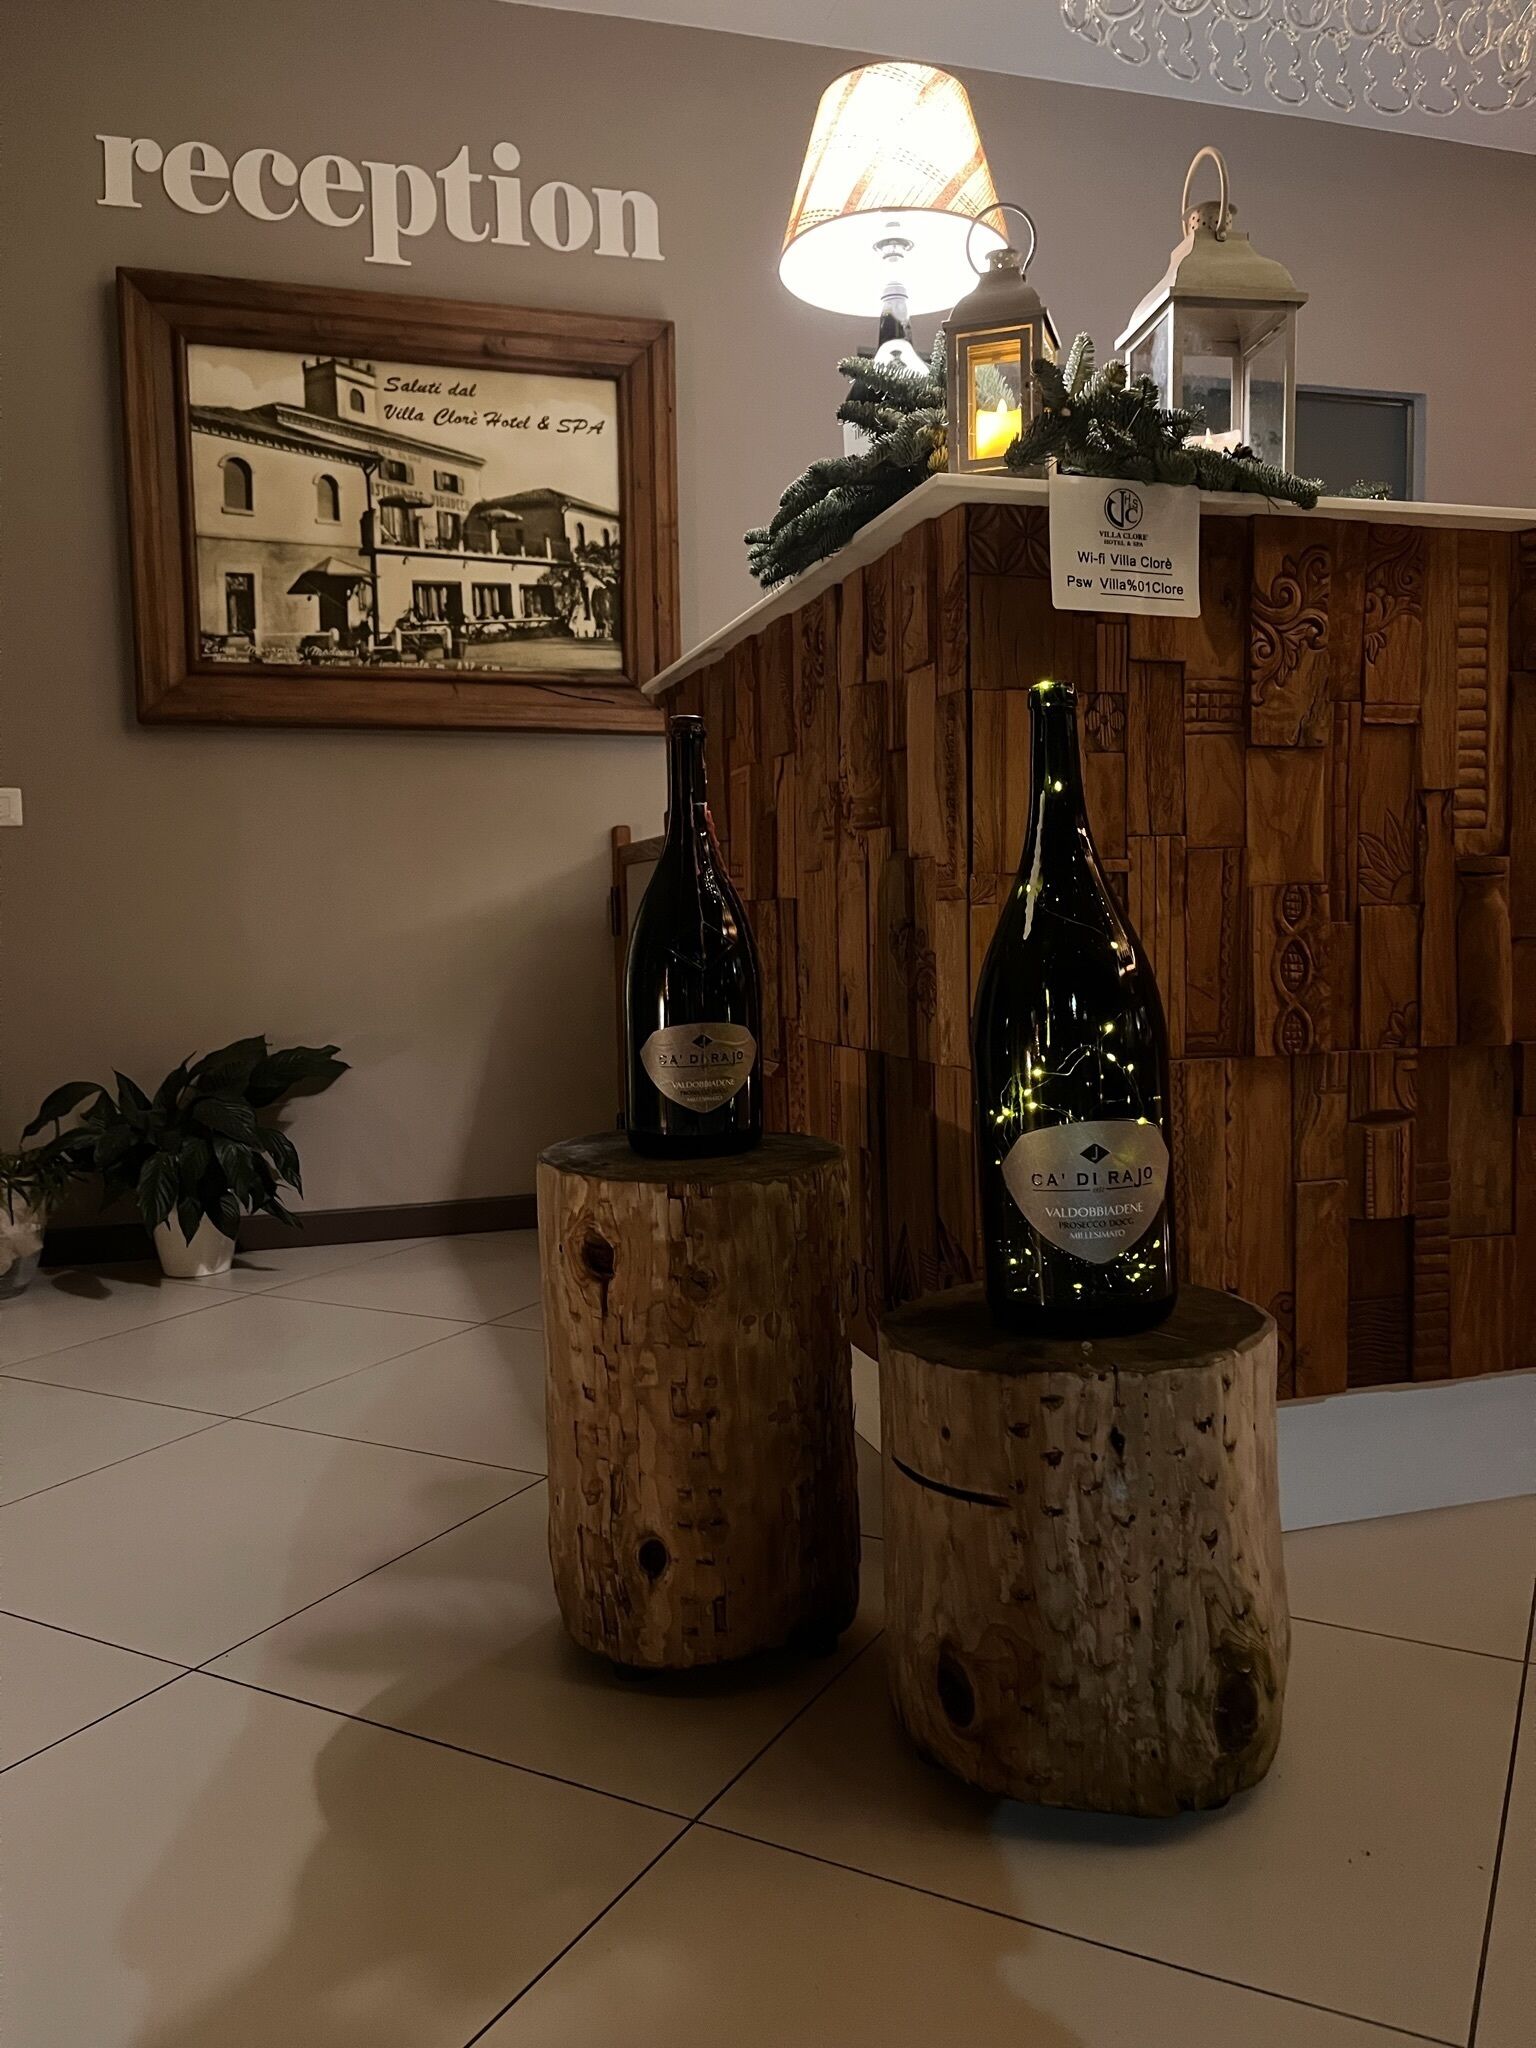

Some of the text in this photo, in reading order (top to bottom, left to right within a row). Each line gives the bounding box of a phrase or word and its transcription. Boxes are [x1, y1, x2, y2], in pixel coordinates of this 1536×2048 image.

[95, 134, 666, 266] reception
[383, 376, 477, 397] Saluti dal
[383, 404, 605, 435] Villa Clorè Hotel & SPA
[1099, 531, 1121, 540] VILLA
[1103, 539, 1125, 547] HOTEL
[1077, 551, 1173, 570] Wi-fi Villa Clorè
[1067, 575, 1184, 595] Psw Villa%01Clore
[711, 1050, 744, 1065] RAJO
[1031, 1166, 1153, 1187] CA' DI RAJO
[1045, 1202, 1144, 1218] VALDOBBIADENE
[1059, 1219, 1107, 1229] PROSECCO
[1069, 1228, 1126, 1240] MILLESIMATO
